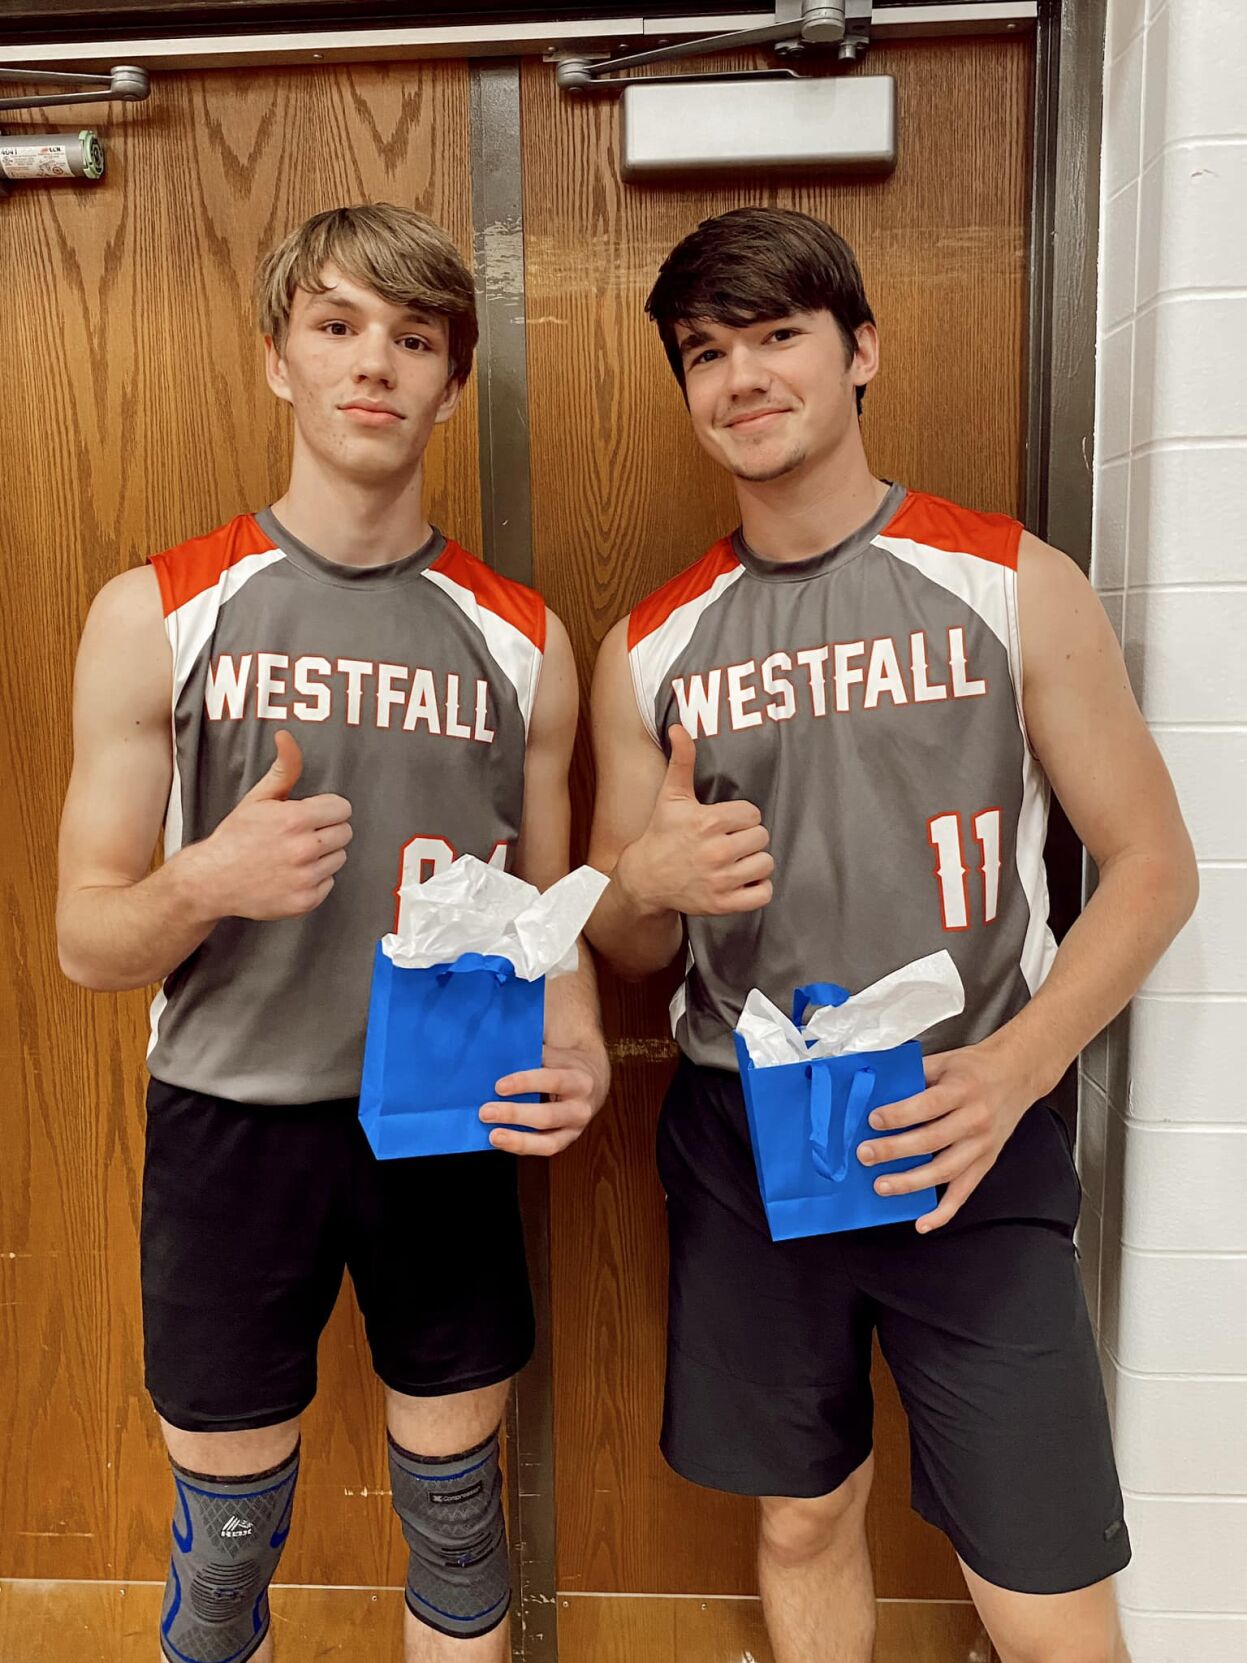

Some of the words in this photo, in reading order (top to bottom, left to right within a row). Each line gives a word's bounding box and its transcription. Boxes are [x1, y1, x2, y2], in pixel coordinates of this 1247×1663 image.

[204, 652, 496, 744] WESTFALL
[671, 626, 987, 740] WESTFALL
[926, 805, 1002, 932] 11
